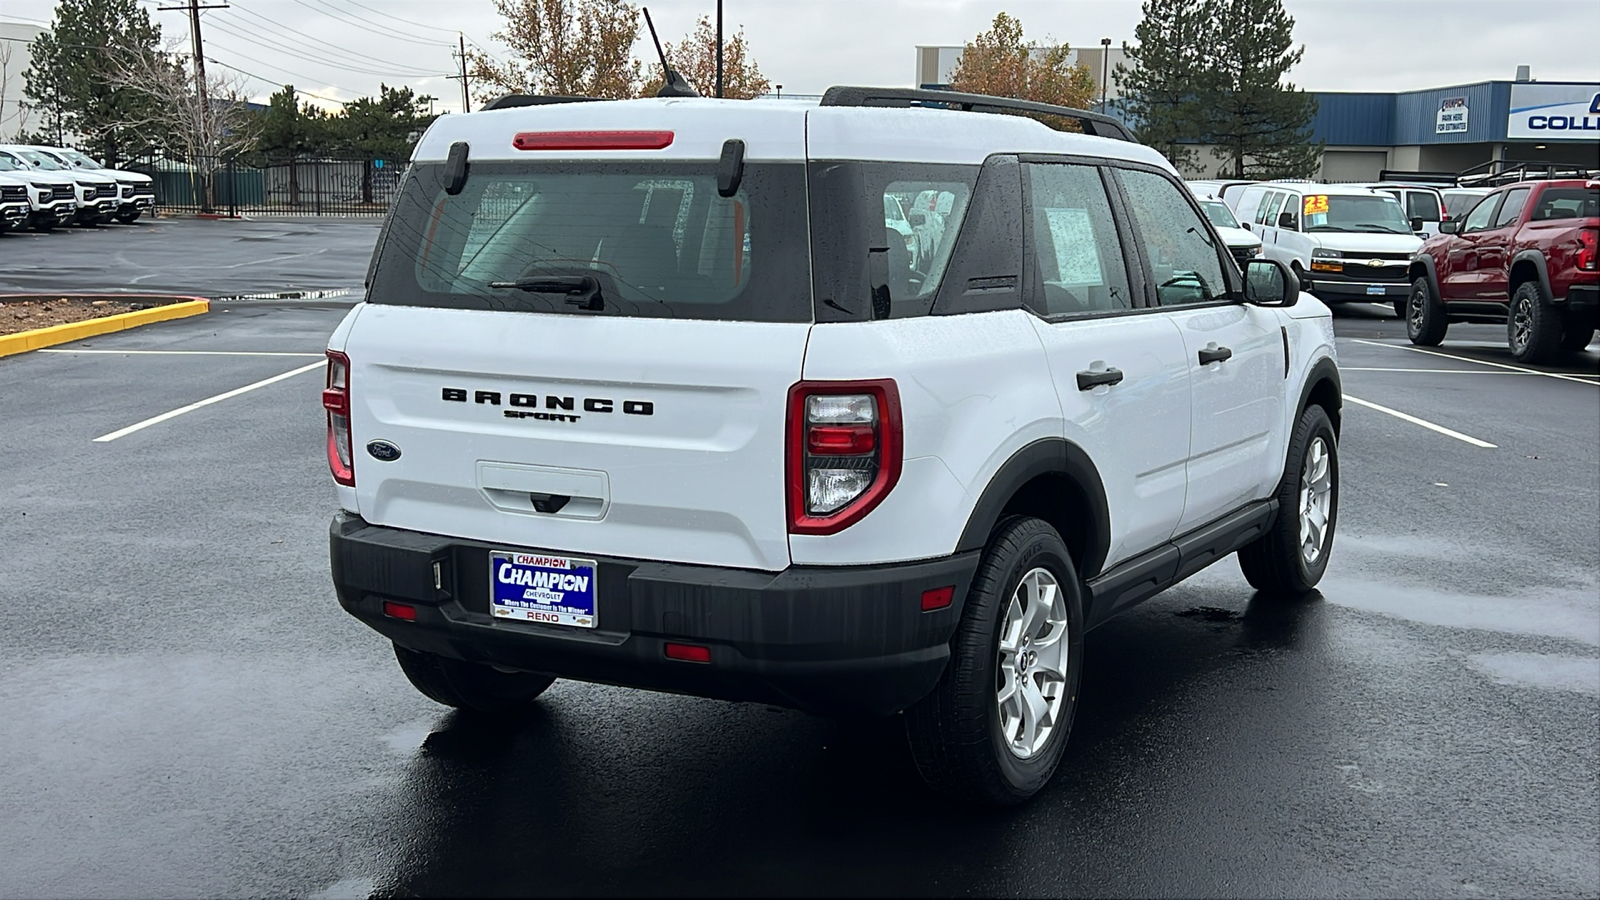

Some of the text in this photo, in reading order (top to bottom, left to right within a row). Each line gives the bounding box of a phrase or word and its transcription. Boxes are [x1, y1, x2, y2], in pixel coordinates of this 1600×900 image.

[1453, 113, 1463, 121] HERE
[1445, 122, 1467, 131] ESTIMATES
[1304, 196, 1328, 207] 23
[442, 387, 654, 416] BRONCO
[503, 410, 581, 423] SPORT
[517, 555, 567, 568] CHAMPION
[498, 563, 589, 593] CHAMPION
[525, 590, 561, 600] CHEVROLET
[529, 602, 552, 611] Customer
[526, 611, 559, 622] RENO
